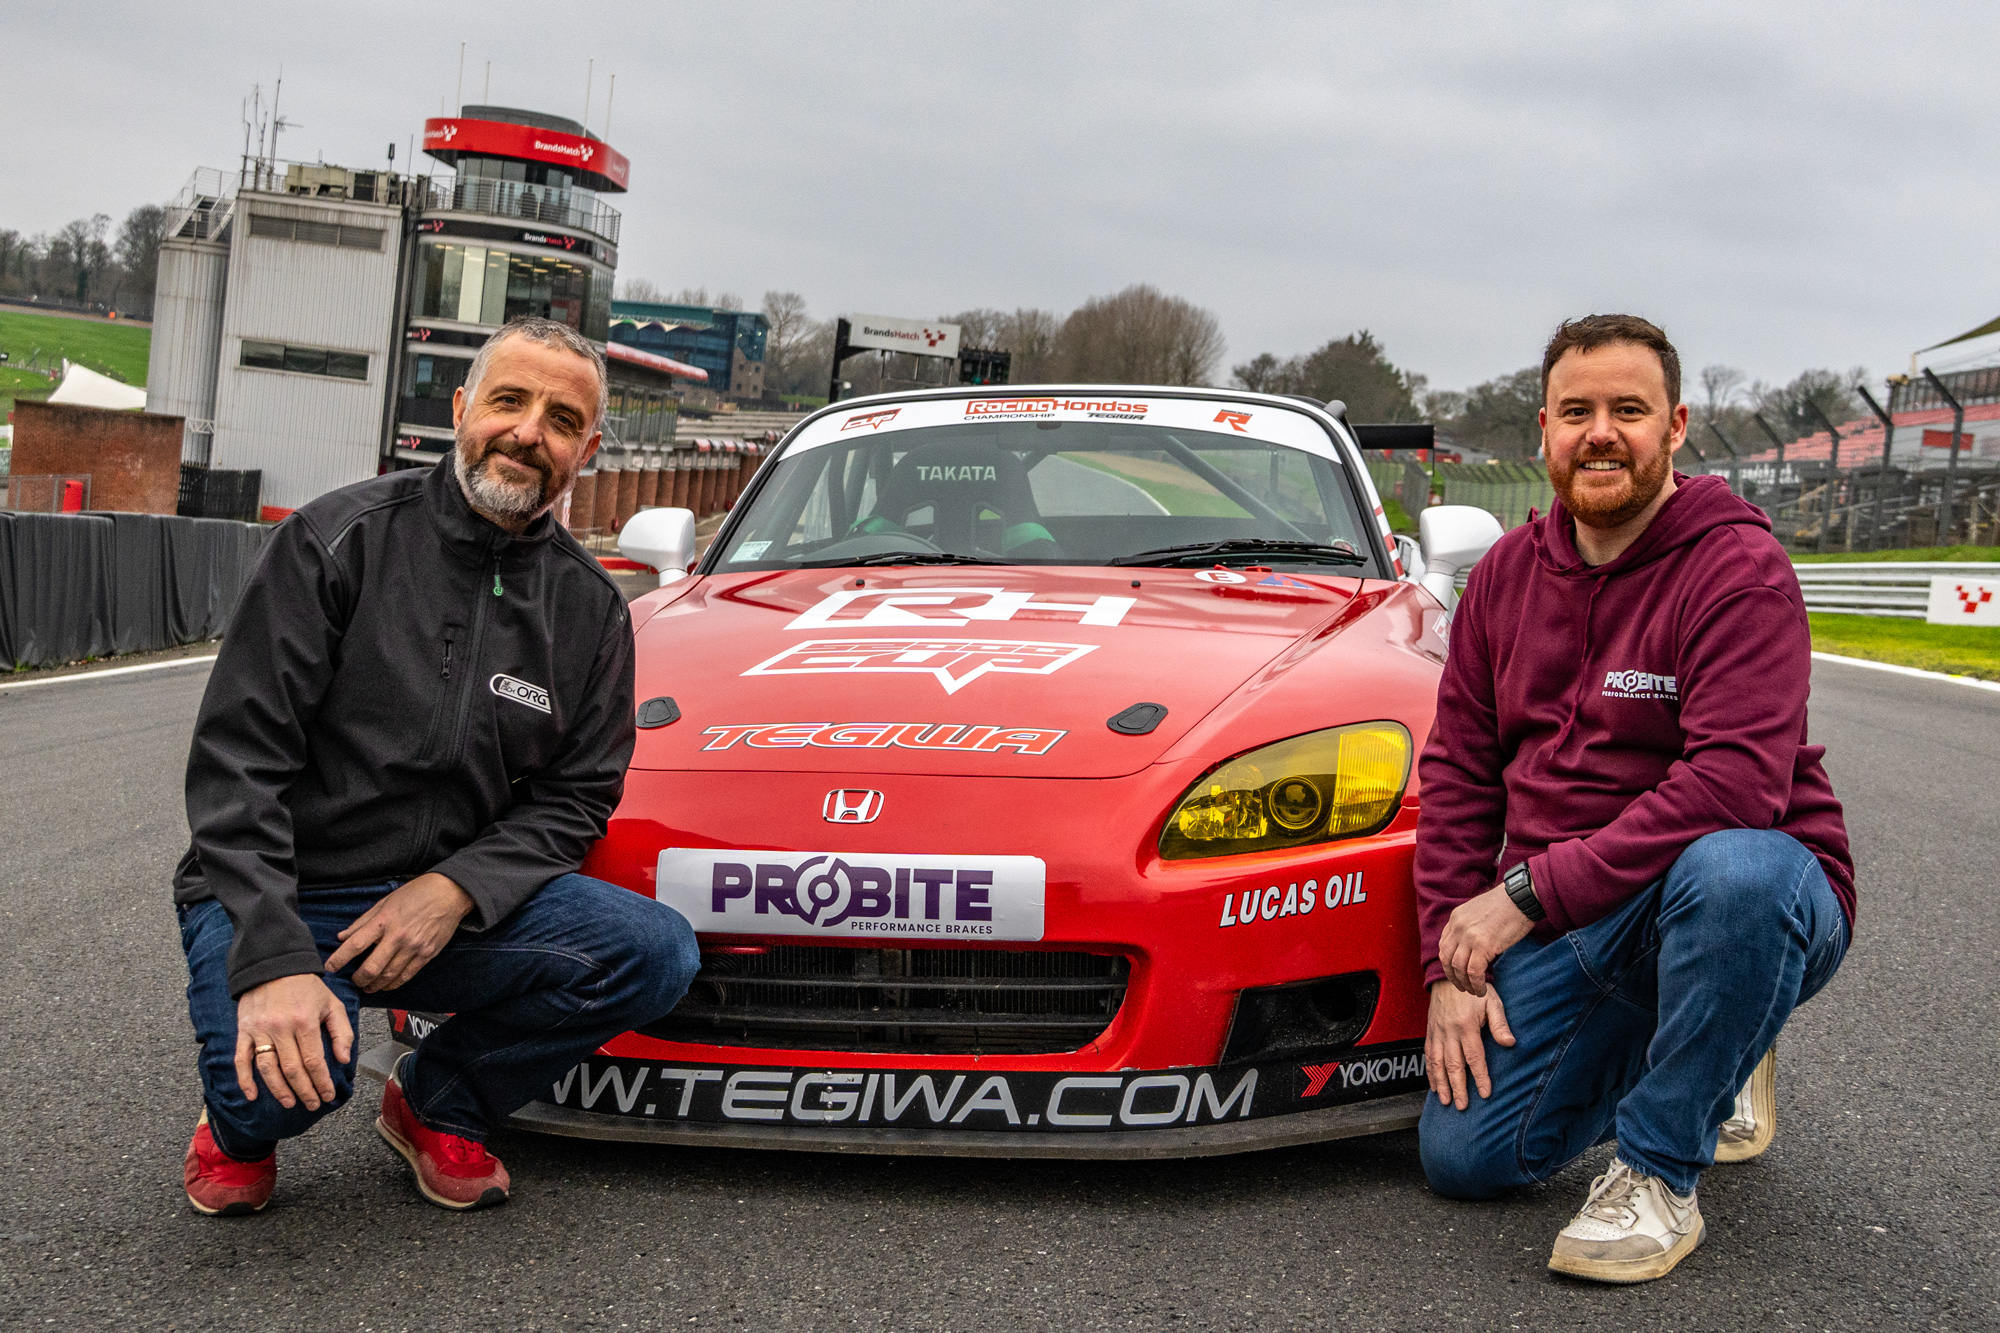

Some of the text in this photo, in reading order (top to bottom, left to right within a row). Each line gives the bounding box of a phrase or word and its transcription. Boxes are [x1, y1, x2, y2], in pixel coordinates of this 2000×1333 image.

[534, 140, 581, 157] BrandsHatch
[863, 326, 920, 341] BrandsHatch
[964, 413, 1056, 421] CHAMPIONSHIP
[1086, 412, 1147, 421] TEGIWA
[916, 465, 997, 482] TAKATA
[1604, 670, 1677, 692] PROBITE
[517, 686, 547, 706] ORG
[1602, 691, 1651, 699] PERFORMANCE
[700, 721, 1071, 756] TEGIWA
[711, 855, 994, 928] PROBITE
[1219, 871, 1368, 928] LUCAS OIL
[851, 921, 993, 935] PERFORMANCE BRAKES
[407, 1013, 439, 1039] YOK
